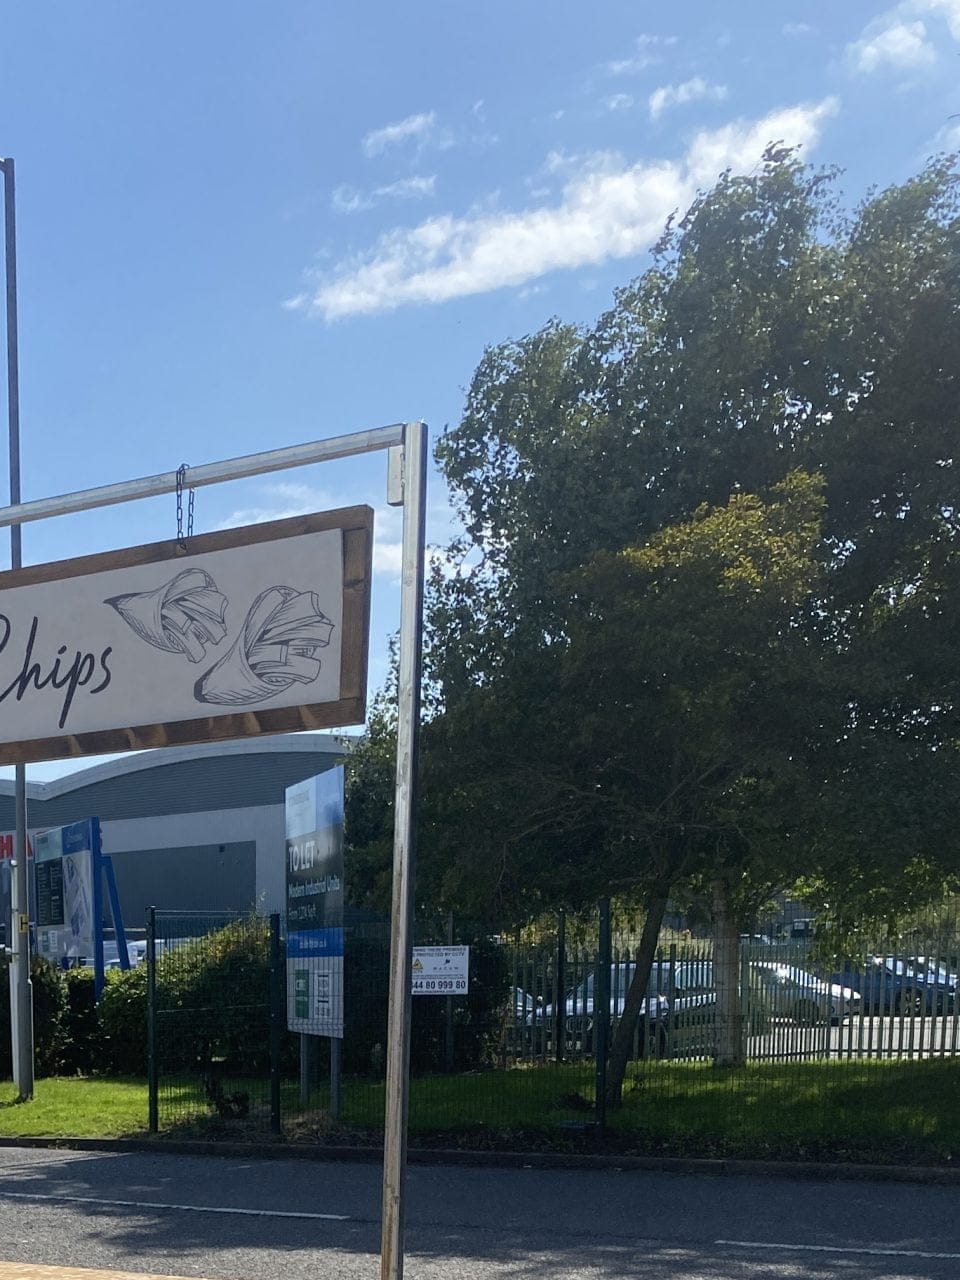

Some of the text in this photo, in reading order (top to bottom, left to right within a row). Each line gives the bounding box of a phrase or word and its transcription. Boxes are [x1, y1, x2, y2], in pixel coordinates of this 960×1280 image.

[288, 840, 316, 872] TO LET
[413, 980, 466, 990] 44 80 999 80
